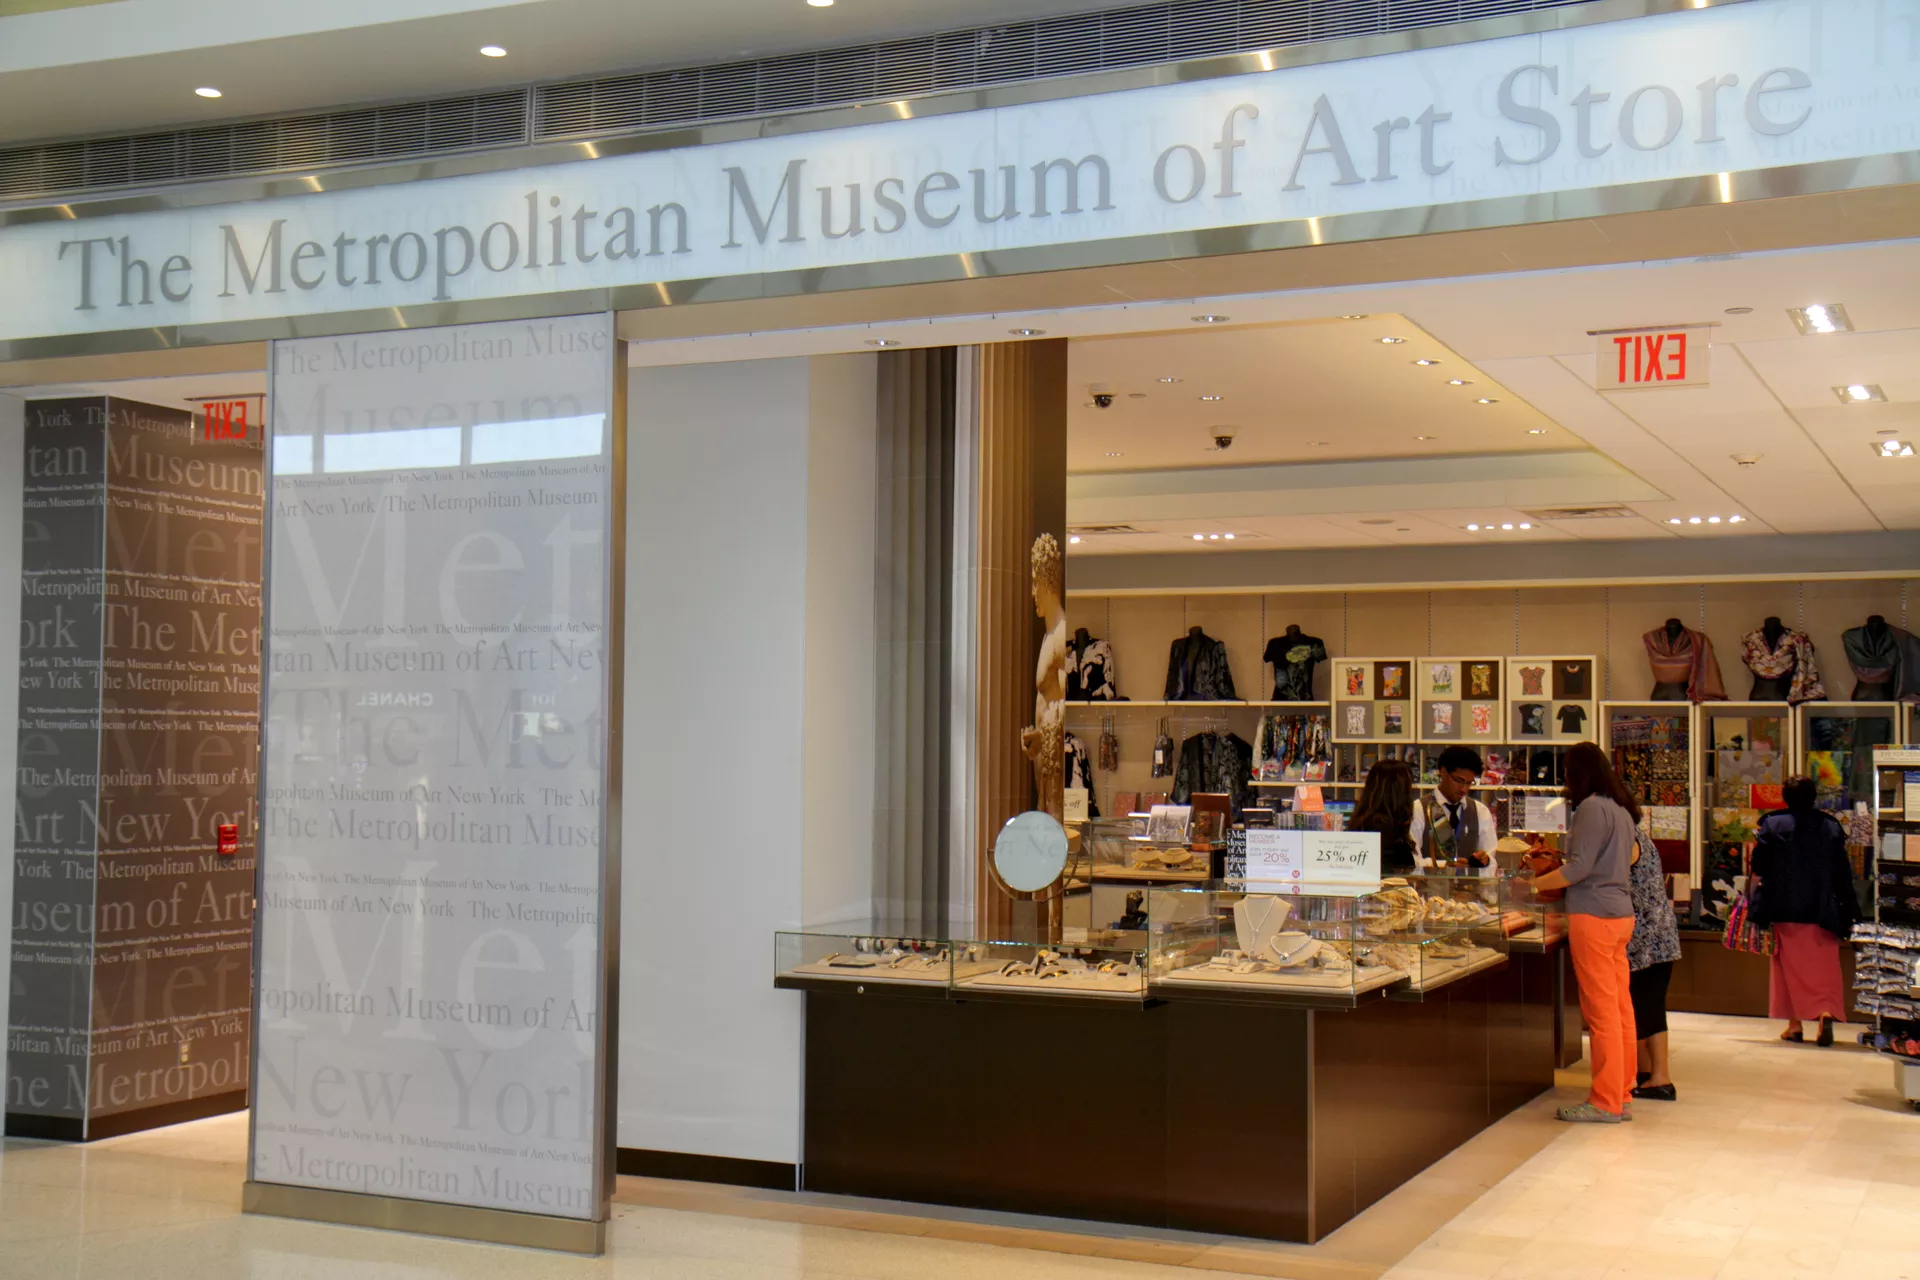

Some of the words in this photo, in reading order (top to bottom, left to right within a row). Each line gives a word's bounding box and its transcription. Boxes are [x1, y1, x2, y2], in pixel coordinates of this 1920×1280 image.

[56, 234, 194, 311] The
[216, 189, 692, 301] Metropolitan
[721, 152, 1116, 250] Museum
[1152, 102, 1260, 204] of
[1281, 91, 1453, 192] Art
[1496, 63, 1813, 167] Store
[272, 345, 321, 376] The
[332, 331, 513, 373] Metropolitan
[37, 408, 72, 429] York
[83, 405, 116, 426] The
[28, 444, 88, 478] tan
[479, 466, 536, 481] Metropolitan
[538, 464, 578, 477] Museum
[275, 501, 297, 519] Art
[301, 499, 335, 516] New
[340, 497, 375, 515] York
[384, 494, 416, 514] The
[421, 487, 521, 514] Metropolitan
[527, 486, 598, 507] Museum
[124, 580, 188, 602] Museum
[192, 583, 208, 603] of
[210, 587, 231, 606] Art
[93, 602, 177, 651] The
[433, 623, 451, 635] The
[512, 621, 551, 633] Museum
[564, 621, 579, 633] Art
[271, 649, 313, 672] tan
[323, 639, 445, 672] Museum
[455, 636, 487, 672] of
[490, 638, 539, 672] Art
[47, 672, 83, 690] York
[89, 670, 122, 690] The
[126, 672, 219, 696] Metropolitan
[18, 767, 50, 786] The
[53, 767, 151, 789] Metropolitan
[156, 767, 218, 786] Museum
[222, 767, 239, 785] of
[329, 784, 394, 804] Museum
[447, 786, 485, 805] New
[487, 786, 526, 806] York
[540, 787, 572, 808] The
[77, 799, 172, 845] New
[268, 807, 319, 839] The
[328, 807, 512, 851] Metropolitan
[17, 858, 52, 878] York
[61, 858, 93, 880] The
[99, 856, 194, 882] Metropolitan
[1263, 852, 1290, 863] 20%
[1316, 849, 1345, 863] 25%
[1349, 850, 1369, 866] off
[486, 878, 507, 891] New
[509, 879, 531, 892] York
[147, 881, 188, 929] of
[193, 879, 251, 925] Art
[331, 893, 348, 912] of
[351, 895, 372, 914] Art
[378, 895, 413, 916] New
[419, 897, 454, 918] York
[467, 899, 500, 920] The
[386, 985, 511, 1027] Museum
[523, 996, 554, 1028] of
[126, 1032, 142, 1051] of
[145, 1030, 168, 1048] Art
[211, 1017, 243, 1038] York
[278, 1144, 460, 1197] Metropolitan
